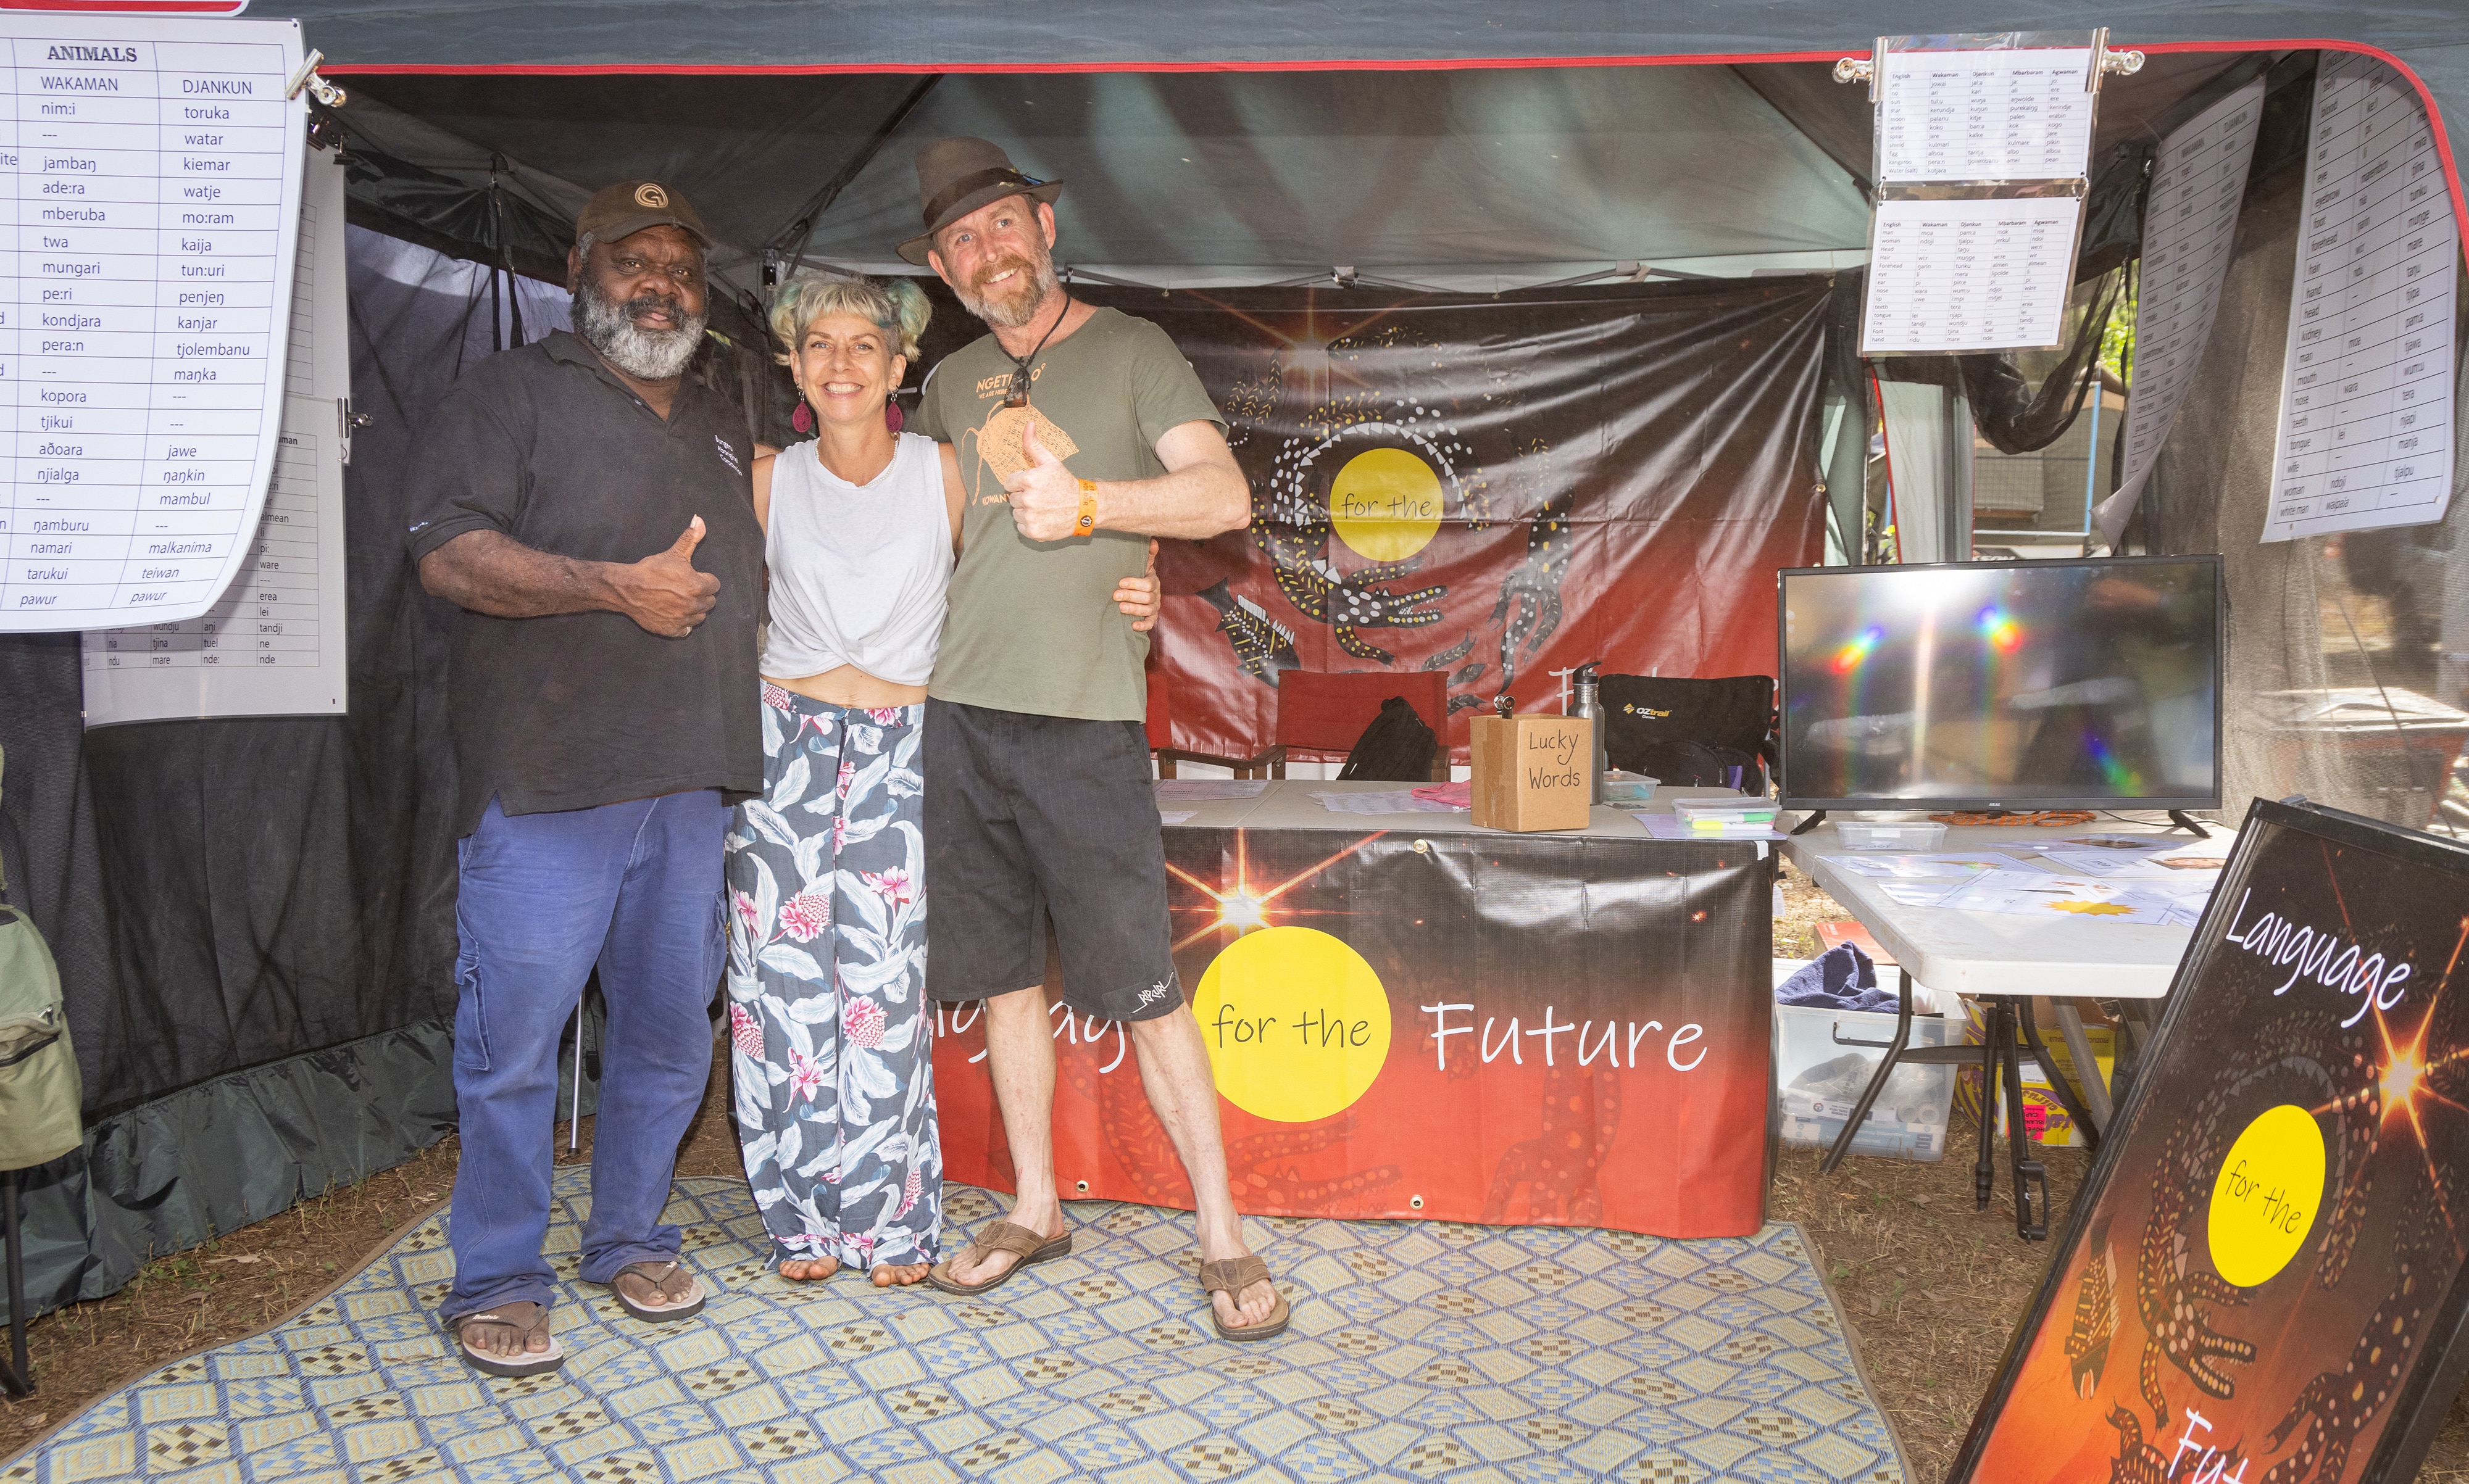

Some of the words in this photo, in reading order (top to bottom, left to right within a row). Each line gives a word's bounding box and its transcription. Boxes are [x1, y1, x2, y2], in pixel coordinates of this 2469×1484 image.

[47, 46, 137, 62] ANIMALS
[41, 77, 118, 91] WAKAMAN
[183, 80, 252, 95] DJANKUN
[42, 102, 75, 115] nim:i
[185, 107, 230, 119] toruka
[185, 135, 223, 146] watar
[184, 157, 230, 172] kiemar
[43, 182, 85, 194] ade:ra
[184, 186, 220, 200] watje
[43, 209, 105, 222] mberuba
[183, 213, 233, 225] mo:ram
[43, 236, 69, 248] twa
[181, 239, 212, 252] kaija
[43, 263, 100, 277] mungari
[181, 265, 225, 276] tun:uri
[43, 289, 72, 302] pe:ri
[43, 314, 101, 329] kondjara
[178, 317, 217, 331] kanjar
[43, 340, 83, 354] pera:n
[177, 344, 250, 357] tjolembanu
[41, 390, 86, 404] kopora
[41, 417, 72, 430] tjikui
[167, 446, 197, 460] jawe
[38, 469, 79, 483] njialga
[160, 494, 210, 506] mambul
[1341, 492, 1378, 520] for
[1388, 494, 1433, 518] the
[31, 543, 72, 555] namari
[149, 542, 212, 555] malkanima
[260, 562, 279, 570] ware
[28, 569, 68, 580] tarukui
[142, 568, 179, 579] teiwan
[20, 594, 57, 608] pawur
[130, 591, 167, 605] pawur
[260, 593, 277, 601] erea
[260, 607, 269, 616] lei
[260, 624, 283, 635] tandji
[153, 637, 167, 650] tjina
[204, 638, 218, 647] tuel
[109, 656, 120, 666] ndu
[260, 655, 275, 664] nde
[1530, 731, 1579, 766] Lucky
[1530, 767, 1580, 790] Words
[2226, 887, 2410, 1028] Language
[1211, 1004, 1277, 1047] for
[1292, 1007, 1372, 1048] the
[1420, 1001, 1707, 1073] Future
[2224, 1159, 2261, 1206] for
[2263, 1191, 2303, 1235] the
